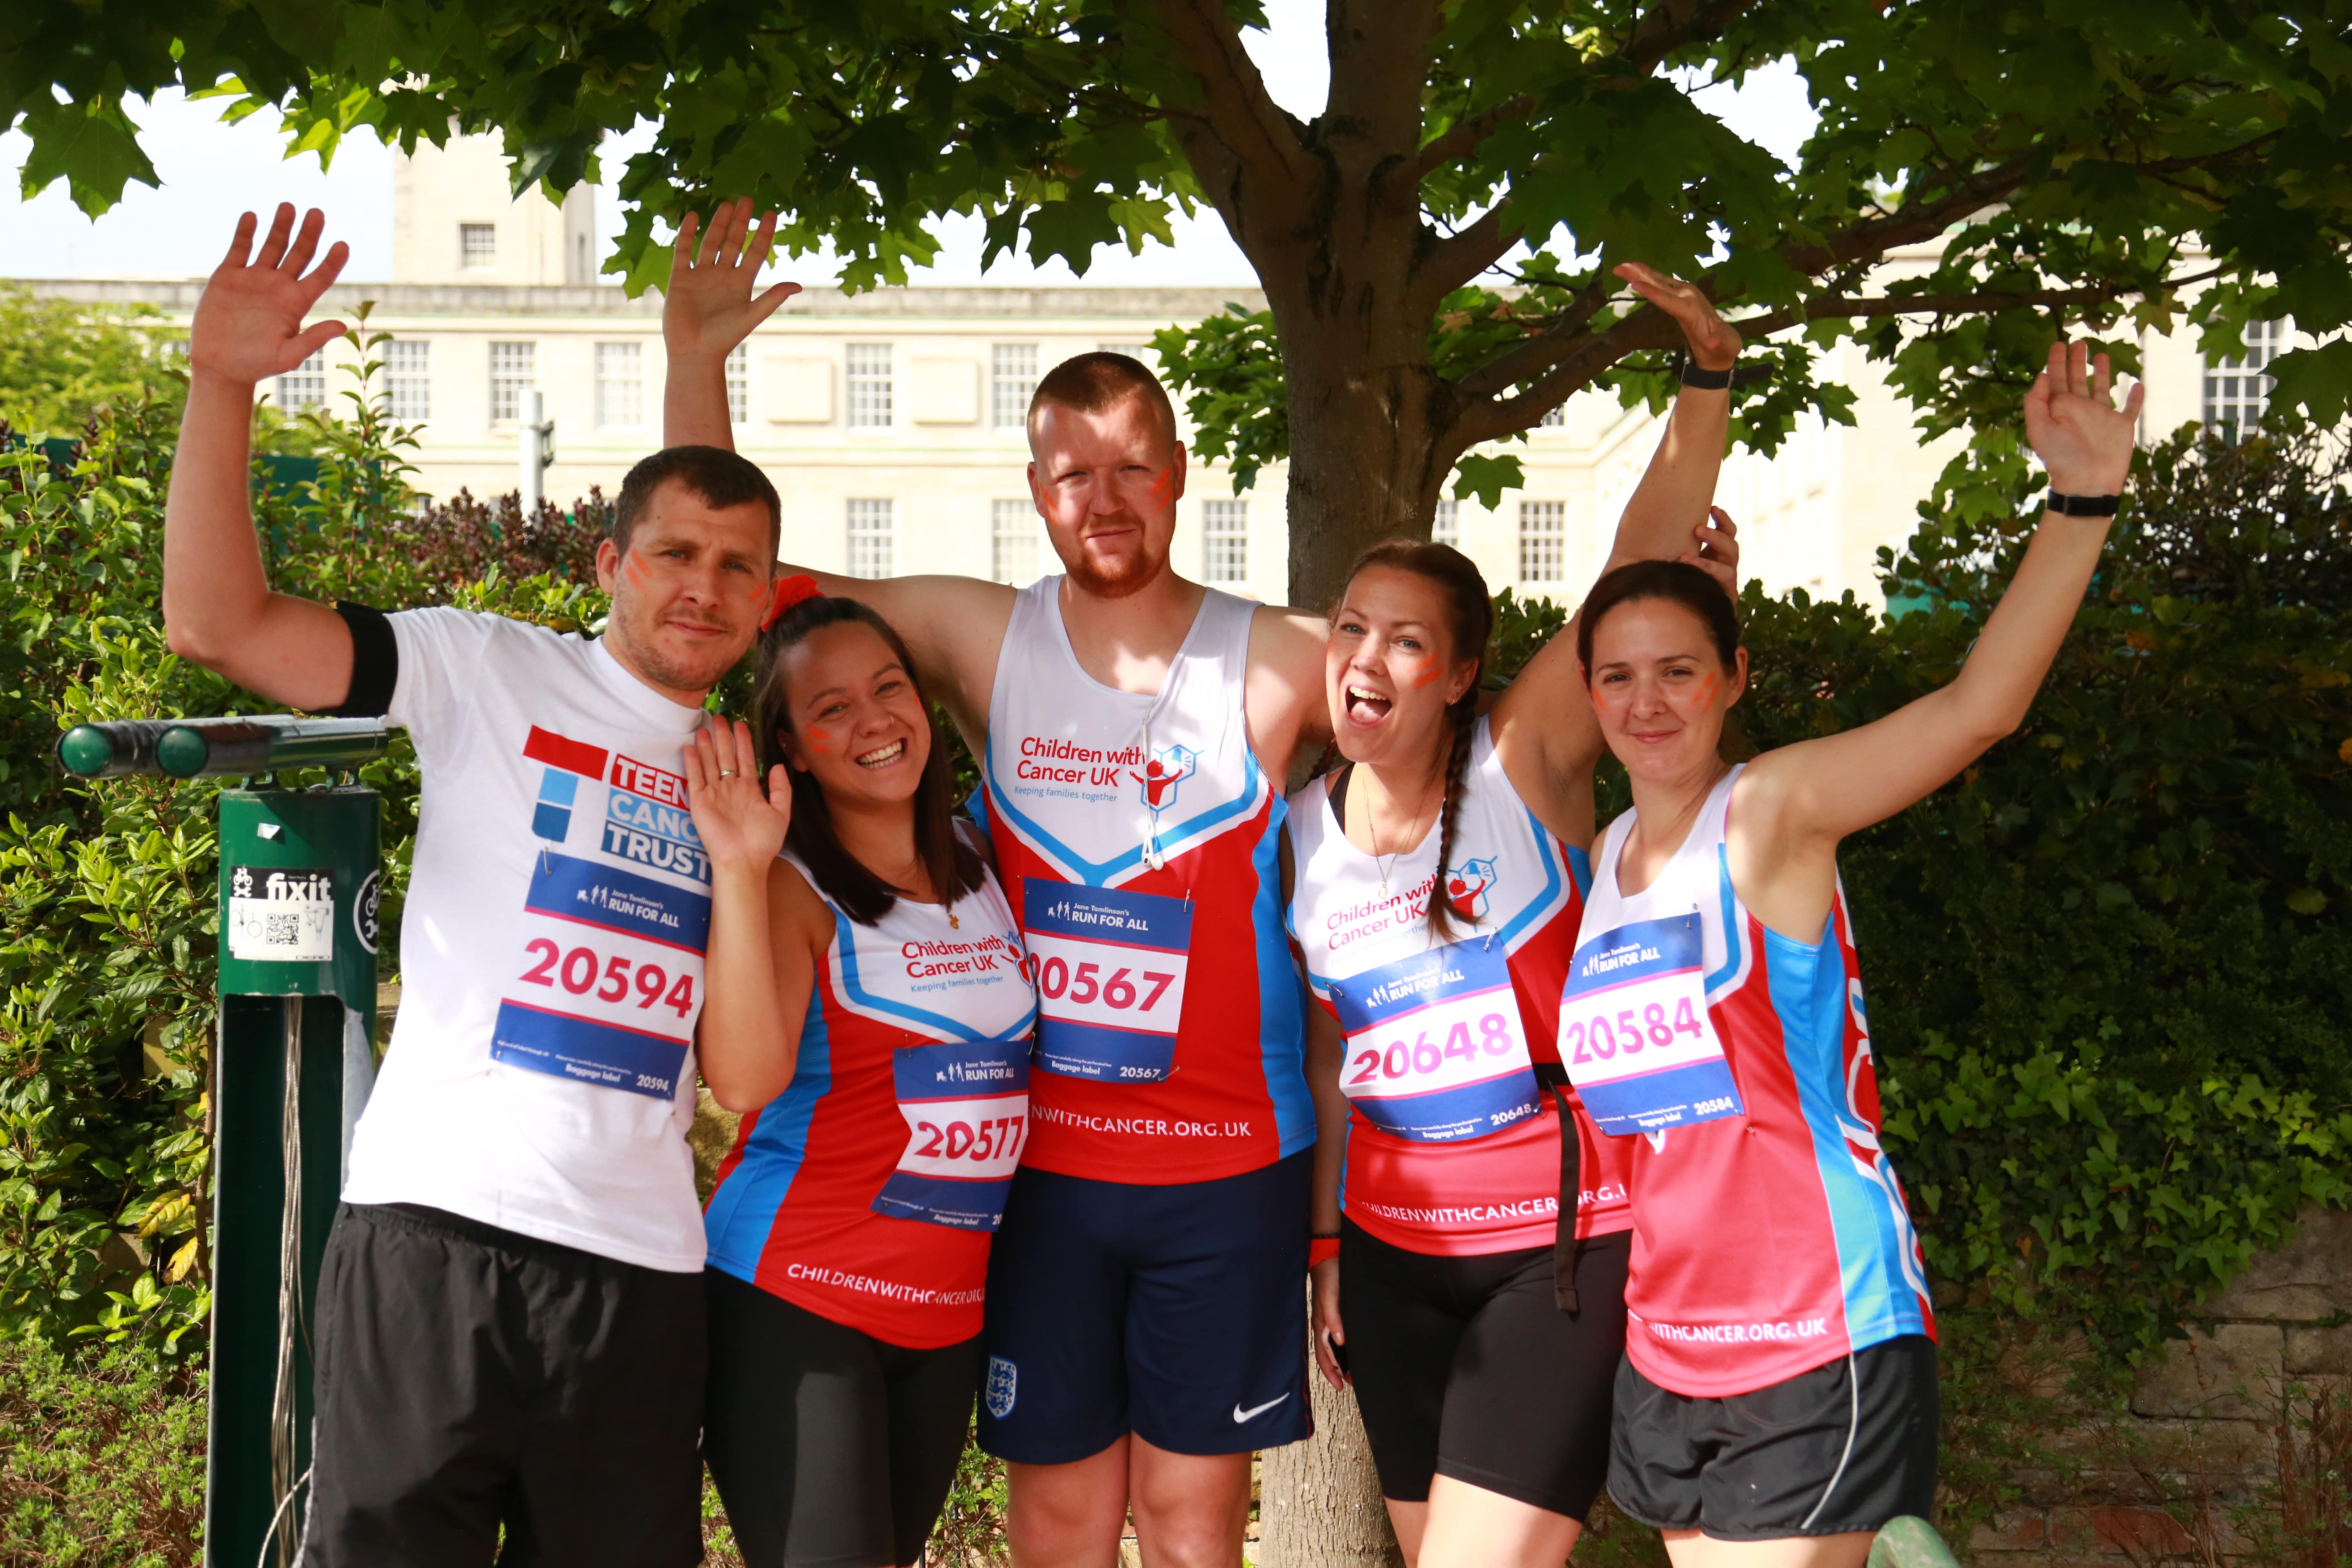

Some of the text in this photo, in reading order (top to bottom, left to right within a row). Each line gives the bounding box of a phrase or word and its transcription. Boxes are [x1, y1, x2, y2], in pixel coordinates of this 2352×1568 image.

[1021, 737, 1145, 766] Children with
[1017, 760, 1120, 787] Cancer UK
[1014, 786, 1118, 802] Keeping families together
[607, 824, 710, 881] TRUST
[266, 873, 331, 901] fixit
[612, 889, 664, 909] Jane Tomlinson's
[608, 898, 679, 928] RUN FOR ALL
[1072, 911, 1149, 931] RUN FOR ALL
[1091, 905, 1129, 916] Tomlinson's
[1327, 895, 1401, 930] Children
[1329, 900, 1426, 950] Cancer UK
[902, 935, 1006, 959] Children with
[1599, 947, 1661, 972] RUN FOR ALL
[517, 938, 694, 1019] 20594
[906, 954, 999, 978] Cancer UK
[911, 976, 1003, 992] Keeping families together
[1388, 980, 1403, 989] Jane
[1389, 969, 1465, 1001] RUN FOR ALL
[1566, 996, 1702, 1065] 20584
[1348, 1013, 1512, 1085] 20648
[566, 1062, 601, 1079] Baggage
[602, 1071, 621, 1082] label
[636, 1074, 669, 1091] 20594
[965, 1068, 1014, 1080] RUN FOR ALL
[1051, 1060, 1161, 1078] Baggage label 20567
[1693, 1096, 1734, 1115] 20584
[1028, 1103, 1252, 1137] NWITHCANCER.ORG.UK
[1422, 1104, 1532, 1139] Baggage label 20648
[914, 1116, 1025, 1161] 20577
